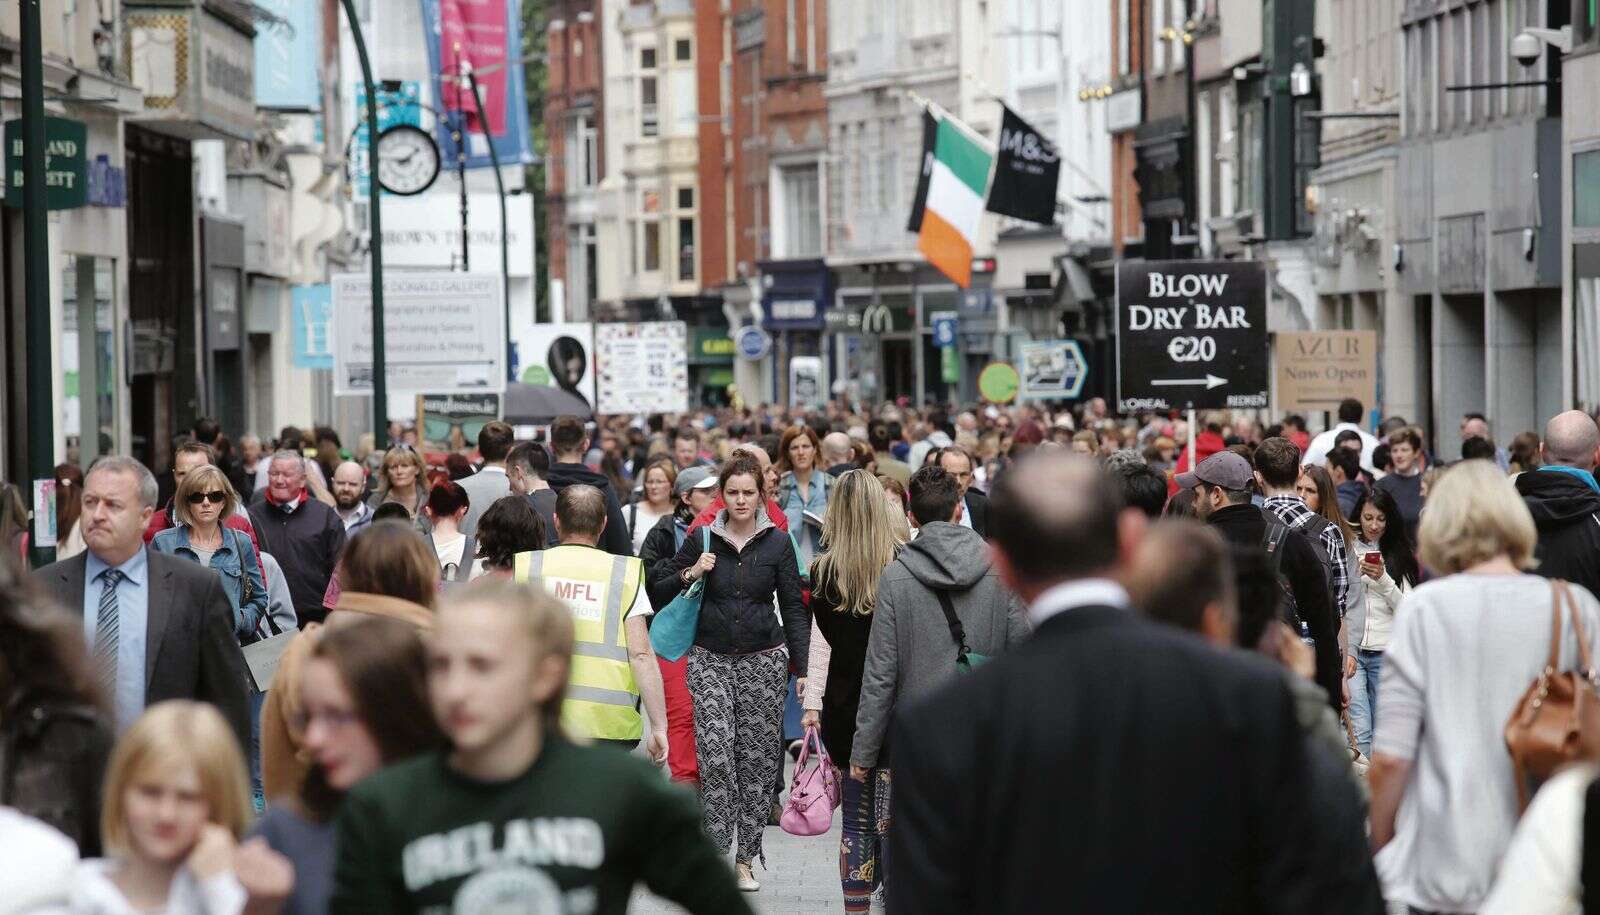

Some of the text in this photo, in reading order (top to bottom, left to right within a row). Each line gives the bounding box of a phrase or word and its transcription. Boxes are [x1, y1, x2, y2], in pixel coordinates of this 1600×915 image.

[380, 229, 437, 246] ROWN
[1128, 303, 1252, 331] DRY BAR
[1167, 335, 1217, 363] €20
[1285, 365, 1367, 384] Now Open
[554, 581, 597, 602] MFL
